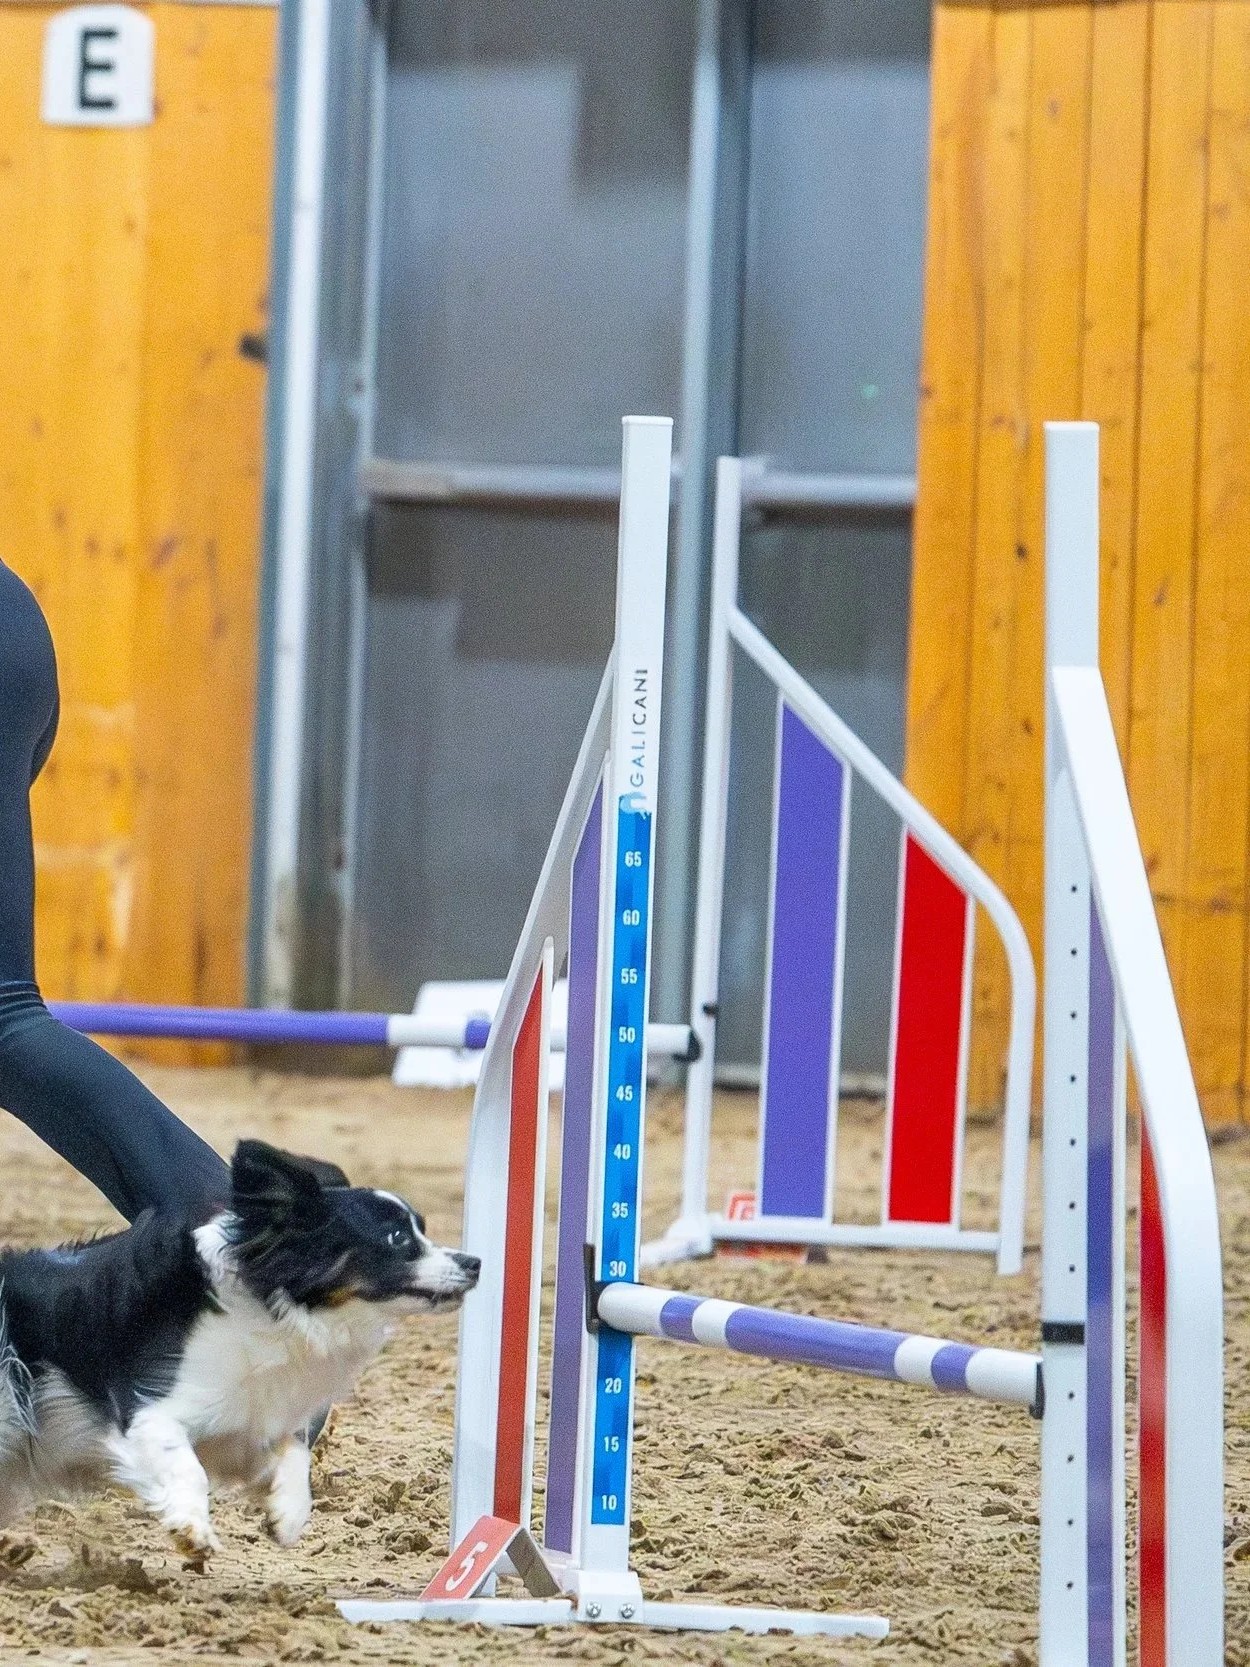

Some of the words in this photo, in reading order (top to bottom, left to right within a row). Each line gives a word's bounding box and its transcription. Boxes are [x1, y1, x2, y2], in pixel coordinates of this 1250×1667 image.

[78, 27, 117, 110] E
[630, 669, 648, 787] GALICANI
[625, 851, 642, 867] 65
[622, 909, 640, 925] 60
[621, 968, 638, 984] 55
[618, 1026, 636, 1043] 50
[616, 1085, 633, 1101] 45
[613, 1143, 631, 1160] 40
[611, 1202, 628, 1218] 35
[609, 1260, 627, 1277] 30
[605, 1378, 622, 1394] 20
[604, 1436, 620, 1452] 15
[601, 1495, 617, 1510] 10
[445, 1541, 489, 1591] 5
